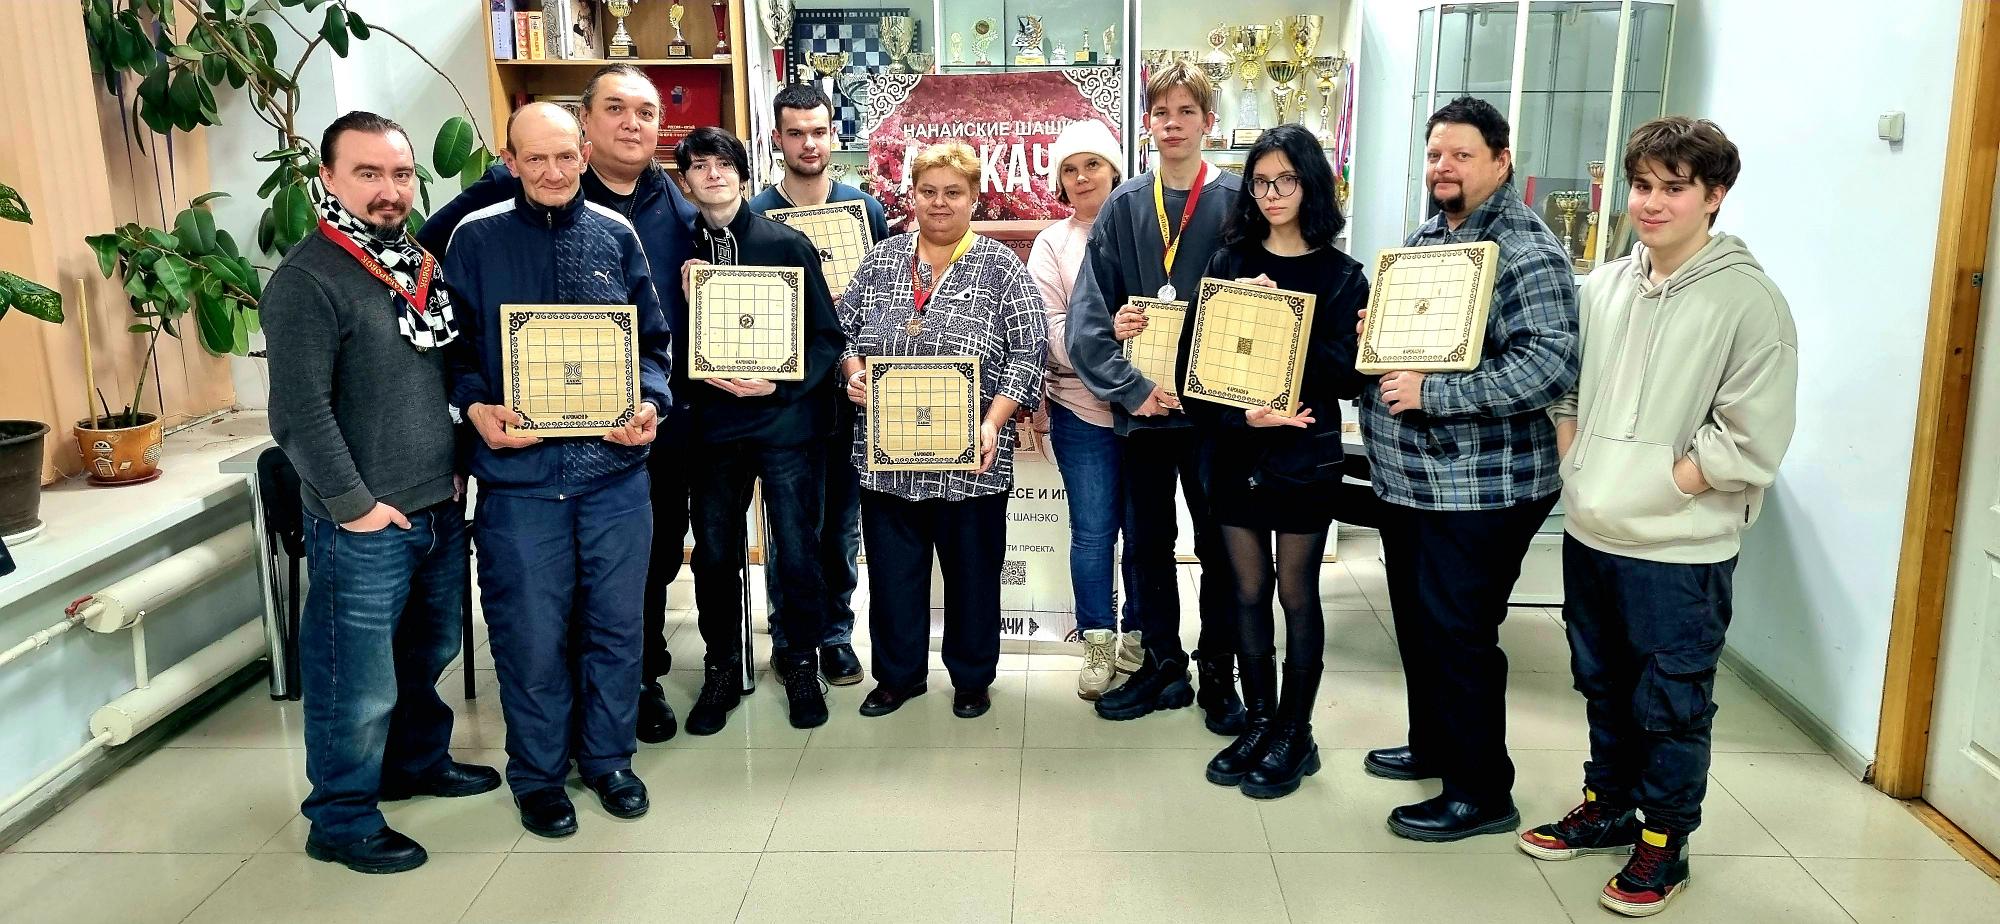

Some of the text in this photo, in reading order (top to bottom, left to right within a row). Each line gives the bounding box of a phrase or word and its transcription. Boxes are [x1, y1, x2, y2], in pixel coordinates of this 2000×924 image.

[903, 120, 1011, 138] НАНАЙСКИЕ
[360, 255, 405, 294] ХАБАРОВСК
[1038, 488, 1048, 500] И
[1013, 512, 1059, 523] ШАНЭКО
[1019, 544, 1055, 553] ПРОЕКТА
